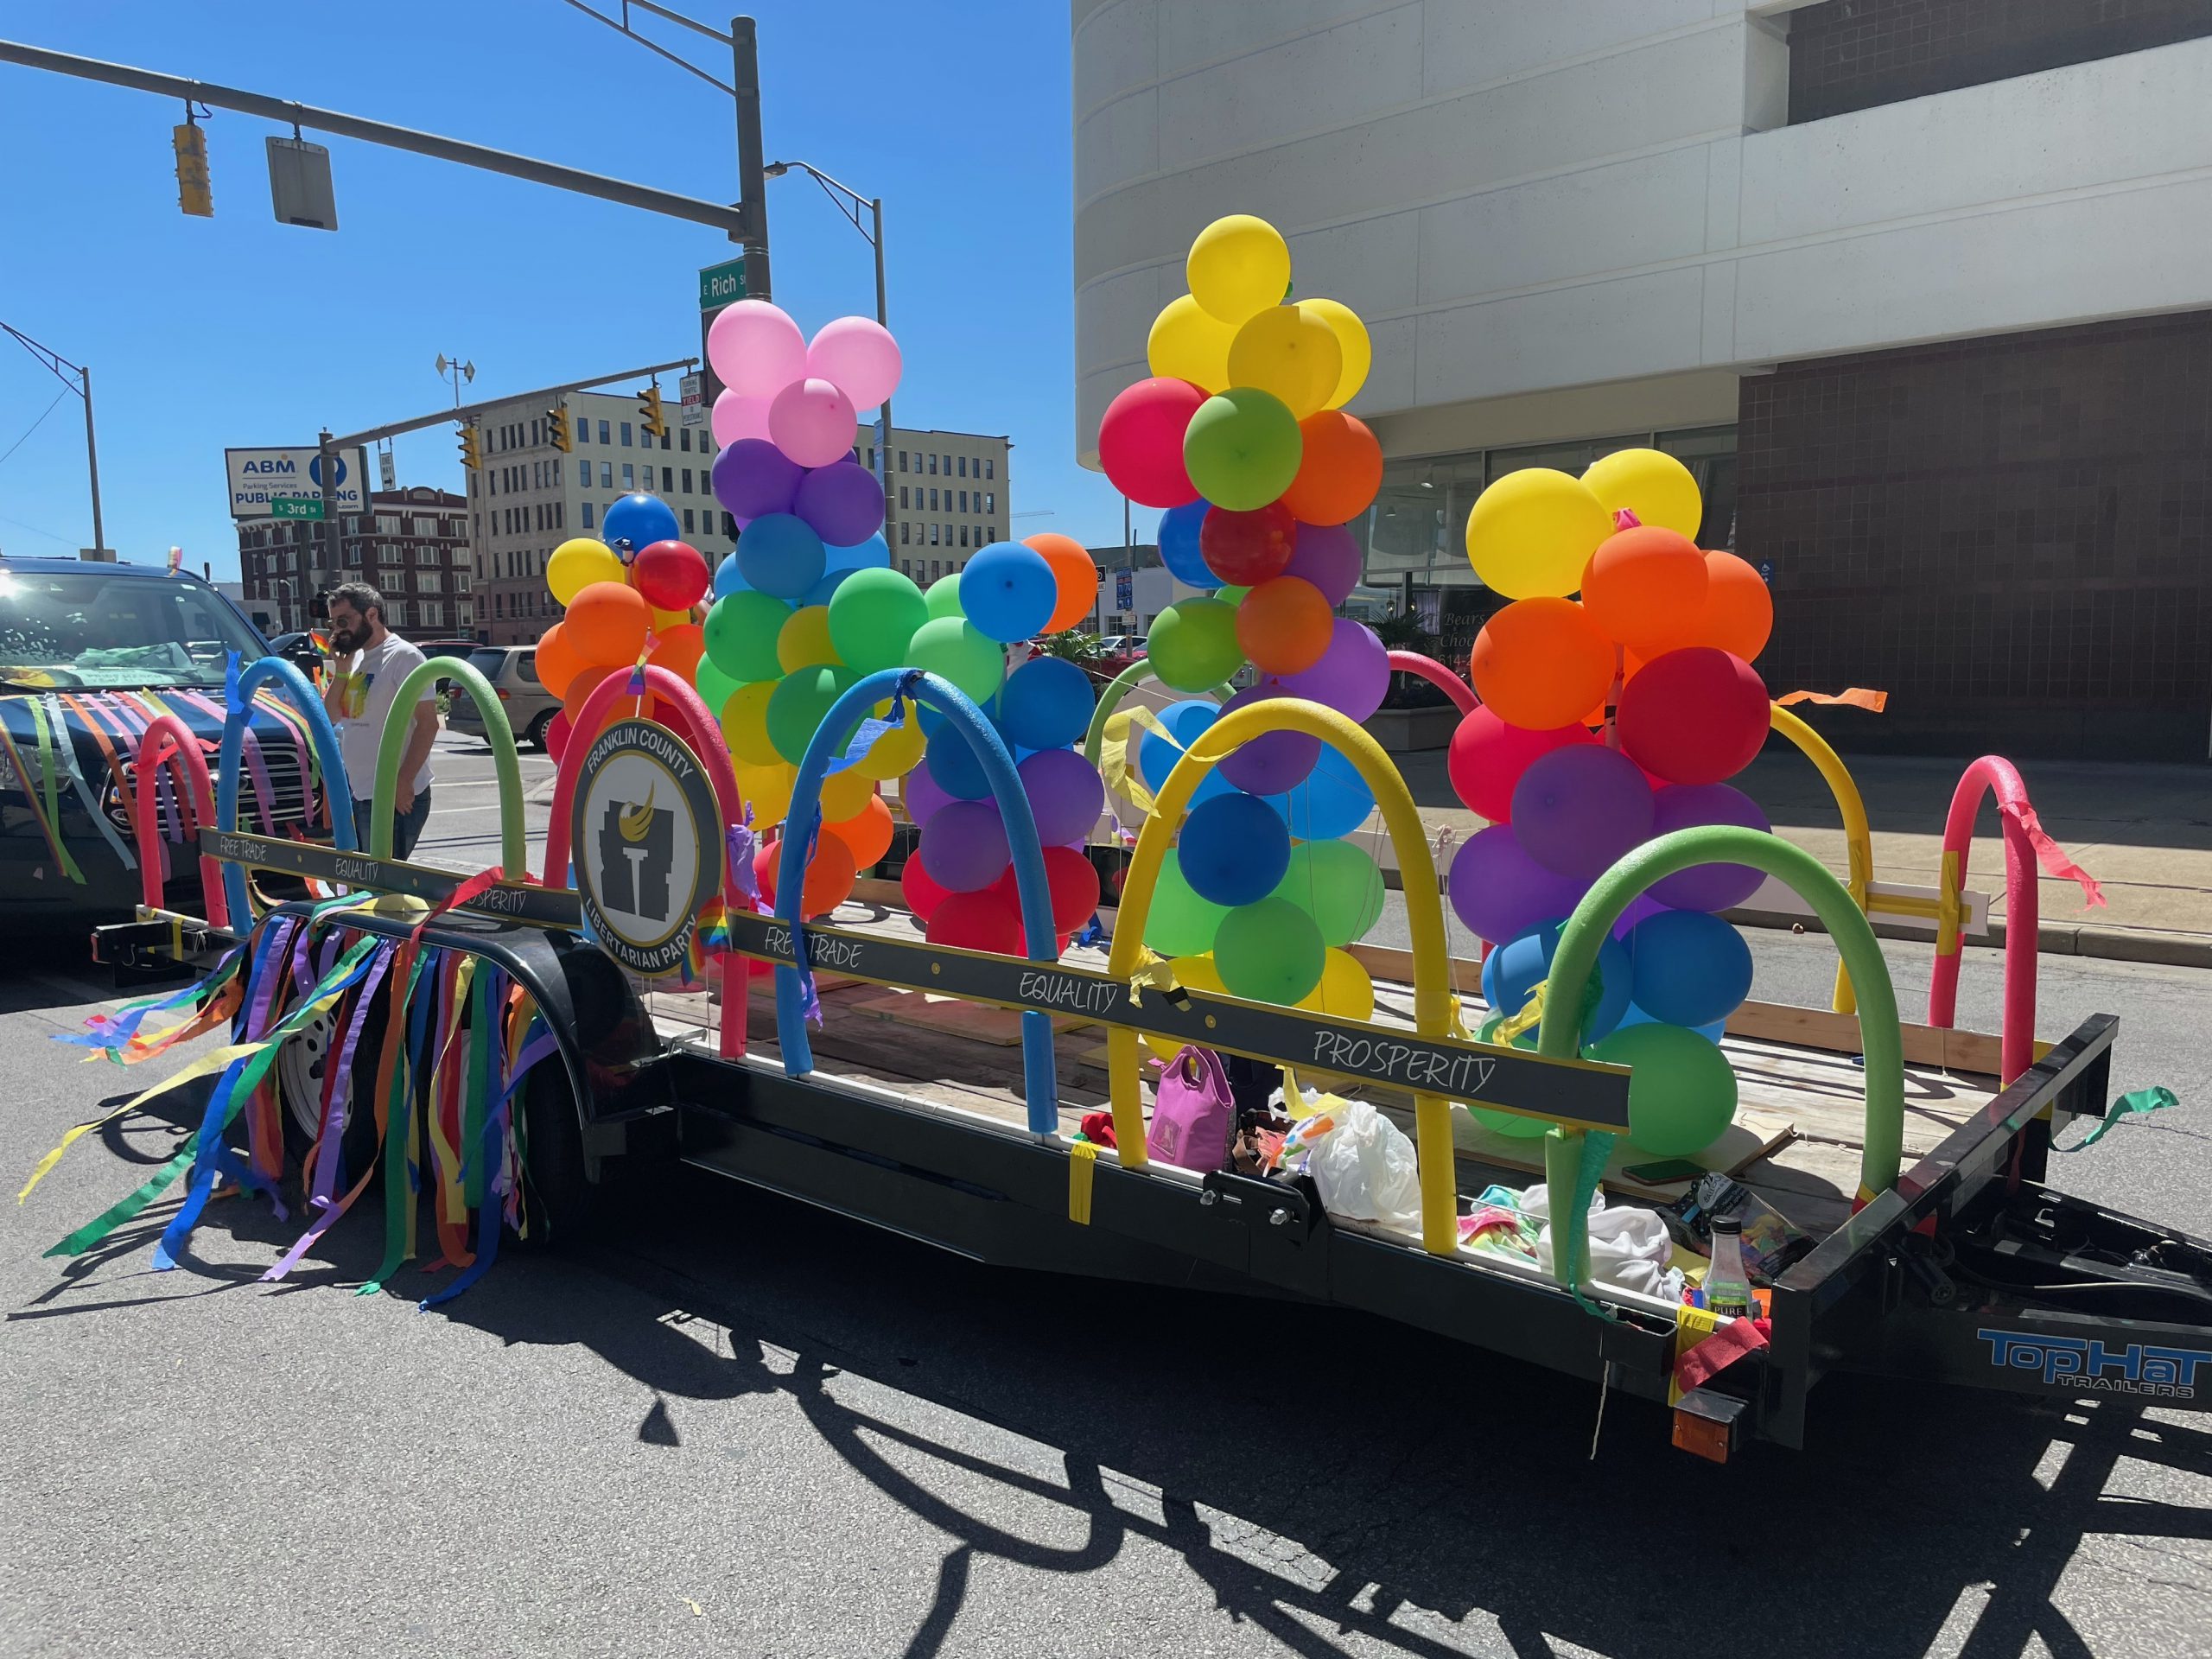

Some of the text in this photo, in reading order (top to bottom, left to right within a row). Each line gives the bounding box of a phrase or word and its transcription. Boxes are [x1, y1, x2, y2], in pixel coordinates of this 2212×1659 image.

[703, 284, 708, 296] E
[711, 274, 736, 297] Rich
[683, 395, 700, 405] YIELD
[243, 460, 296, 474] ABM
[293, 490, 358, 501] PARNG
[287, 503, 307, 515] 3rd
[1445, 613, 1485, 626] Bears
[588, 728, 694, 779] FRANKLIN COUNTY
[219, 836, 267, 862] FREE TRADE
[335, 858, 378, 882] EQUALITY
[455, 882, 526, 912] OSPERITY
[586, 897, 696, 969] LIBERTARIAN PARTY
[809, 933, 864, 968] TRADE
[1019, 971, 1117, 1014] EQUALITY
[1313, 1030, 1496, 1093] PROSPERITY
[1714, 1306, 1744, 1316] PURE
[2056, 1374, 2195, 1399] TRAILERS
